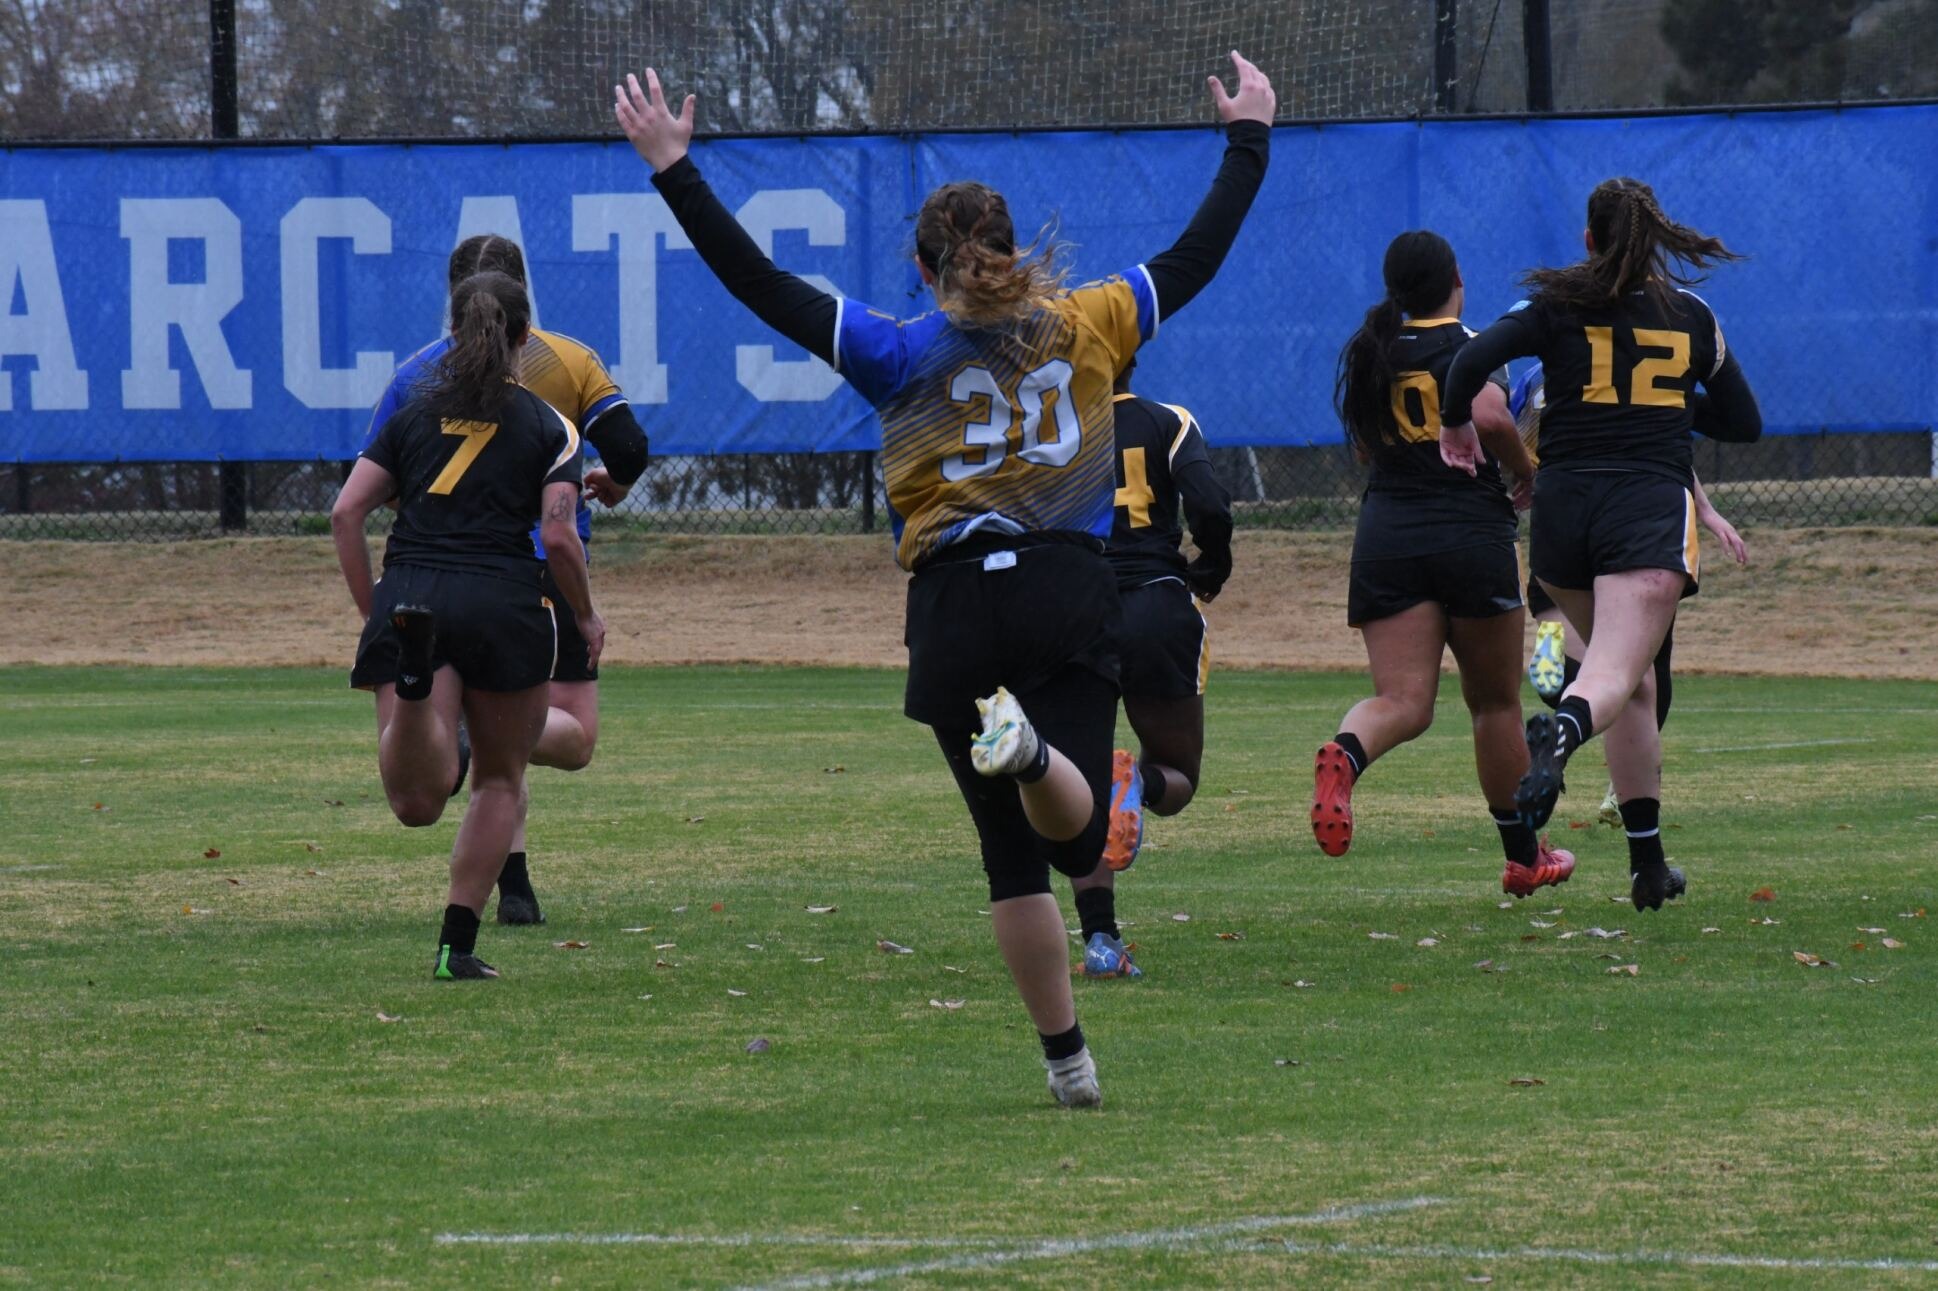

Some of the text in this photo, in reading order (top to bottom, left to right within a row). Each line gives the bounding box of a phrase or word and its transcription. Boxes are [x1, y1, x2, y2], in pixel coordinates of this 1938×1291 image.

[0, 188, 846, 412] ARCTS
[1582, 326, 1690, 408] 12
[427, 416, 499, 495] 7
[941, 357, 1082, 482] 30
